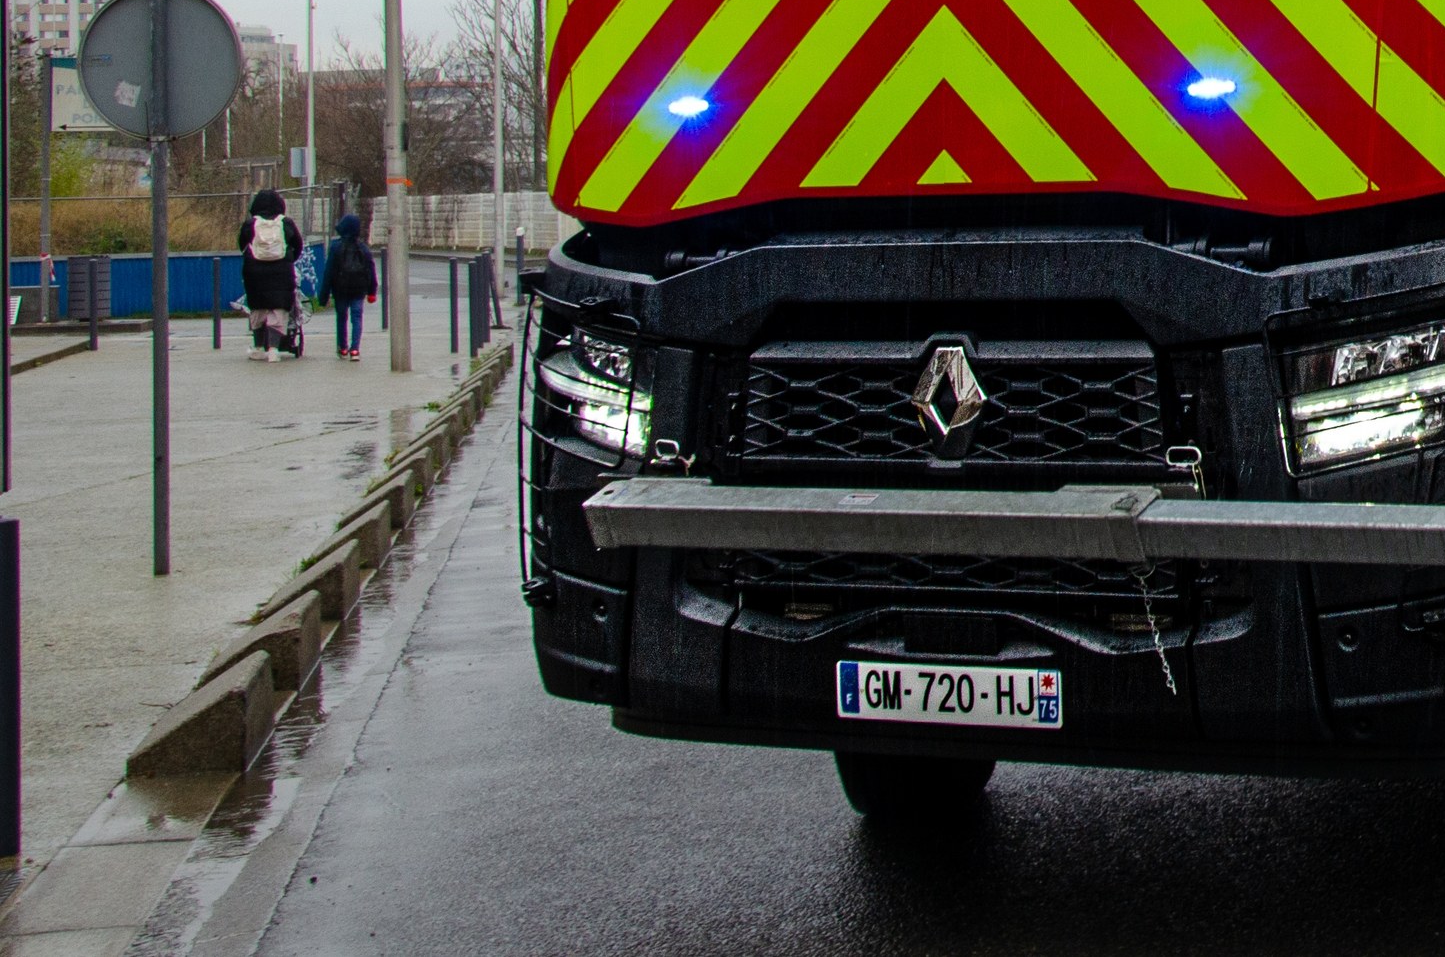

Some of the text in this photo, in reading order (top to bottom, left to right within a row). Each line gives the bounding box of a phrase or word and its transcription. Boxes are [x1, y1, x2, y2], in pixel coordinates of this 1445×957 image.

[846, 694, 852, 705] F
[865, 669, 1035, 715] GM-720-HJ
[1040, 699, 1057, 718] 75
